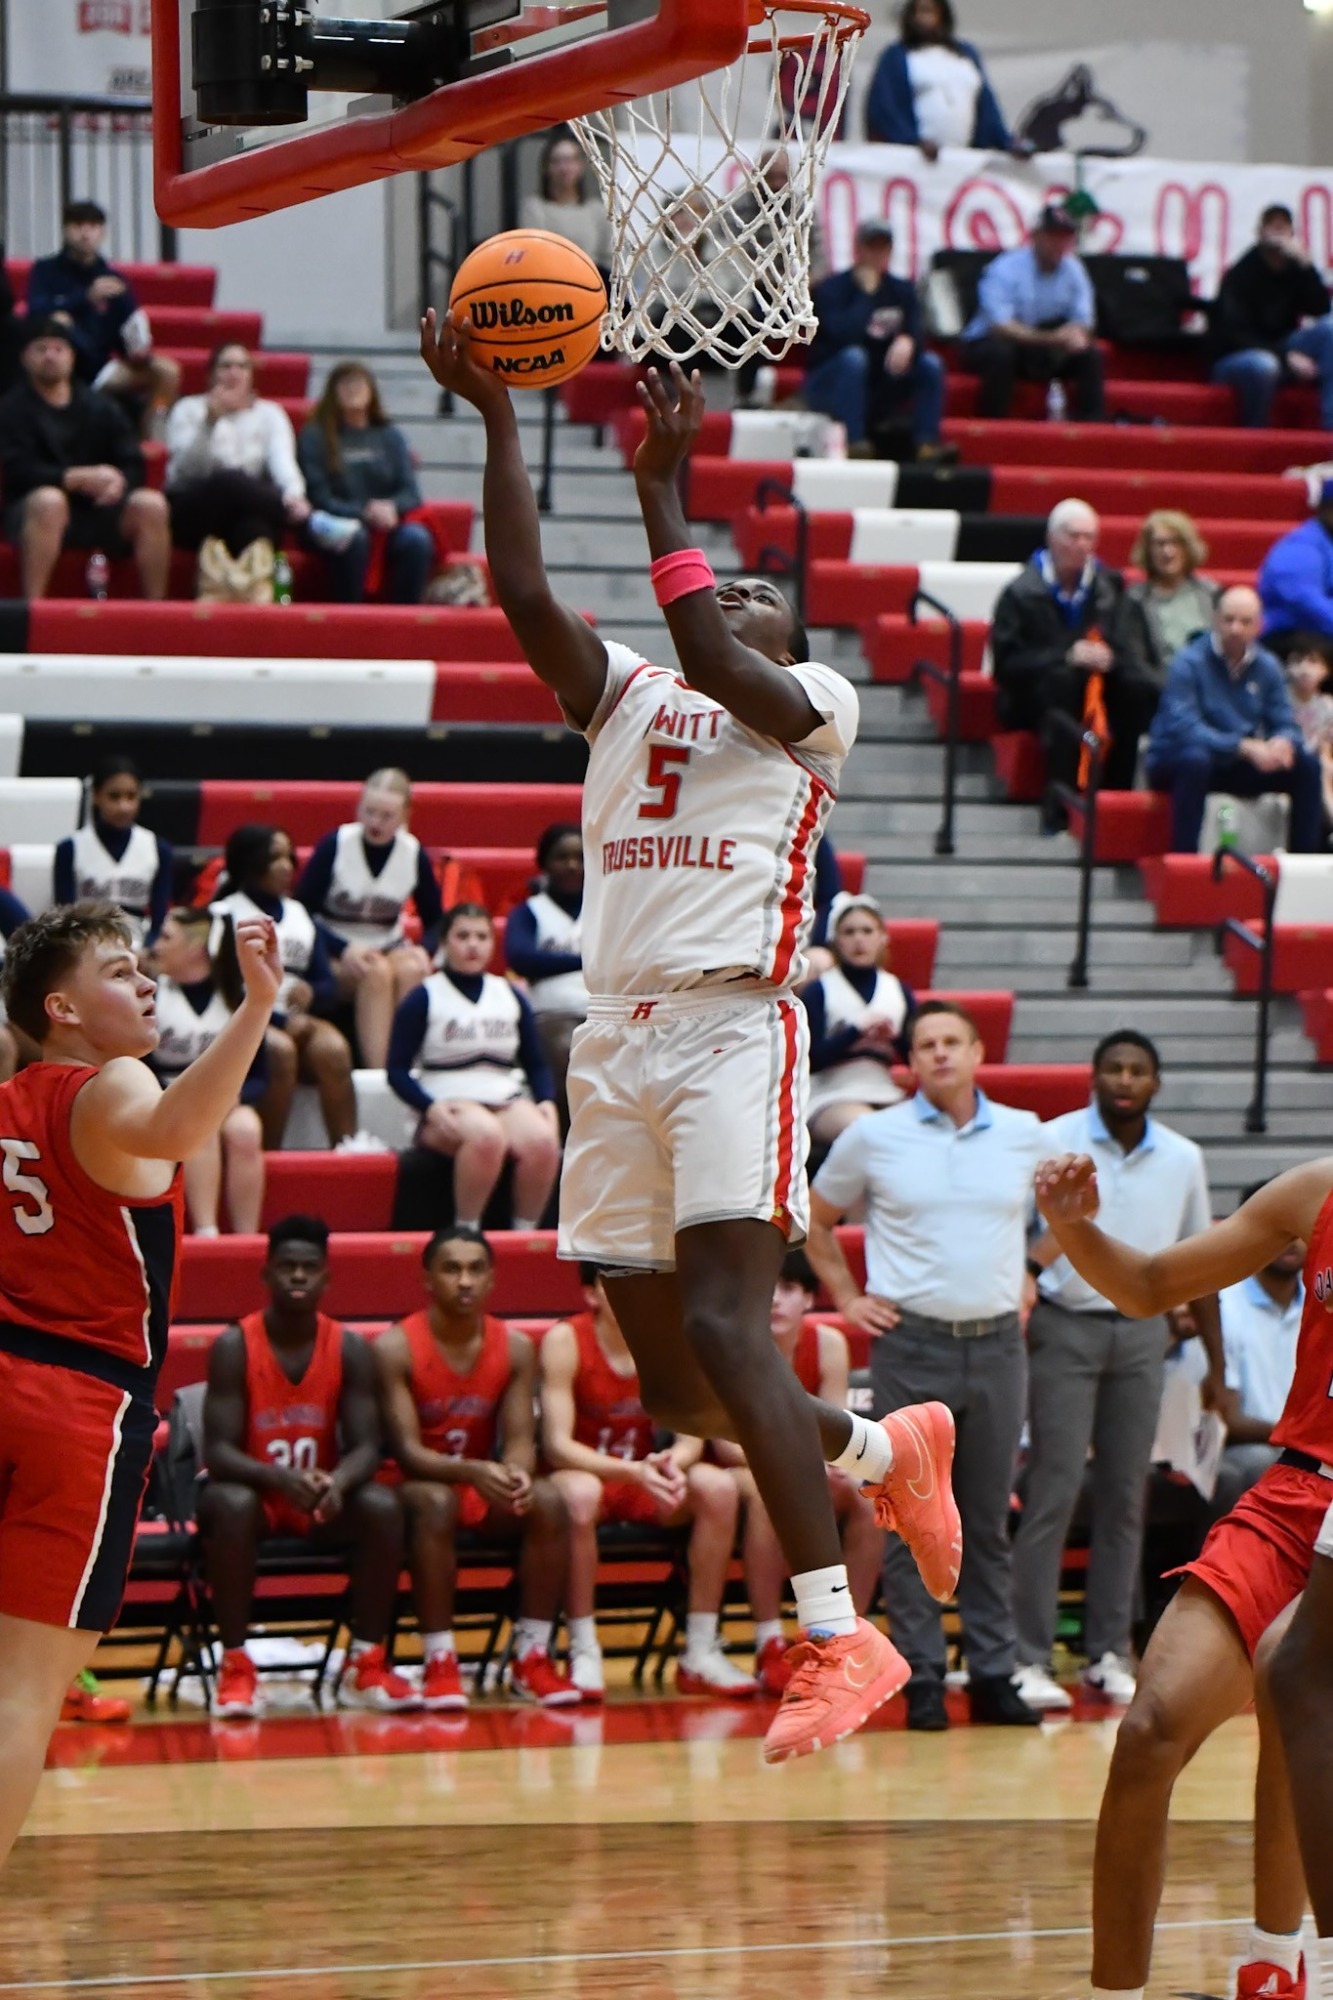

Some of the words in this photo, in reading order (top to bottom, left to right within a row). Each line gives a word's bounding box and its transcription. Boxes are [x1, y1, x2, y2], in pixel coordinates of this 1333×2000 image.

[469, 298, 574, 330] Wilson
[493, 347, 565, 373] NCAA
[637, 743, 692, 822] 5
[0, 1137, 56, 1235] 5
